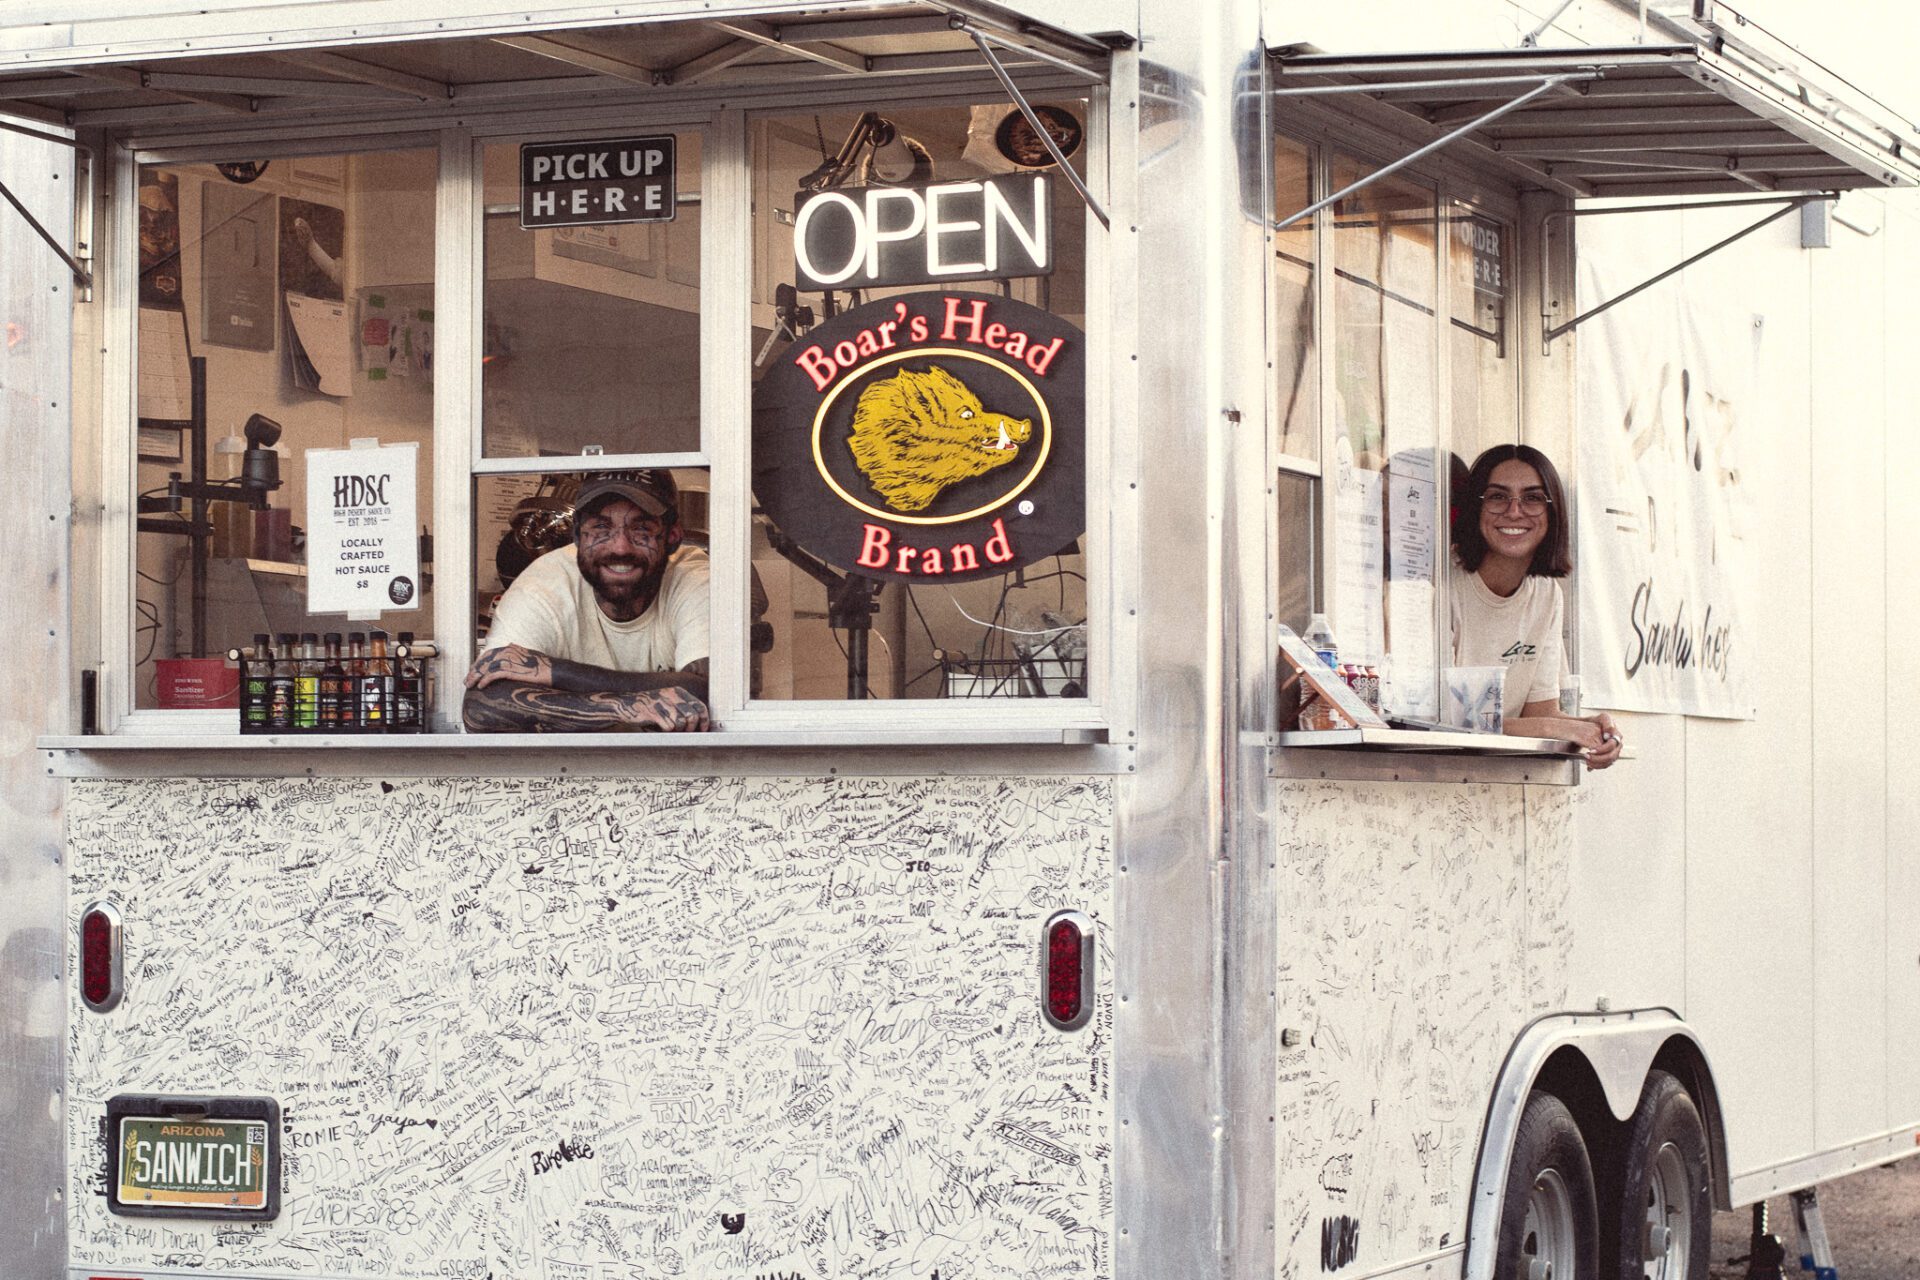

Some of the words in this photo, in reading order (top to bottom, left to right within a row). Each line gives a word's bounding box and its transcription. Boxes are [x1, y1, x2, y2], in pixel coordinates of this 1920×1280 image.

[532, 151, 609, 182] PICK
[619, 149, 664, 177] UP
[793, 176, 1046, 284] OPEN
[1460, 221, 1500, 257] ORDER
[795, 302, 929, 393] Boar's
[940, 297, 1065, 377] Head
[333, 473, 391, 508] HDSC
[347, 508, 366, 517] DESERT
[367, 507, 383, 516] SAUCE
[341, 538, 384, 548] LOCALLY
[856, 517, 1015, 575] Brand
[340, 551, 384, 561] CRAFTED
[335, 566, 354, 575] HOT
[358, 565, 390, 574] SAUCE
[356, 579, 369, 589] $8
[451, 897, 481, 918] LONE
[160, 1125, 225, 1137] ARIZONA
[1059, 1123, 1092, 1137] JAKE
[135, 1140, 252, 1186] SANWICH
